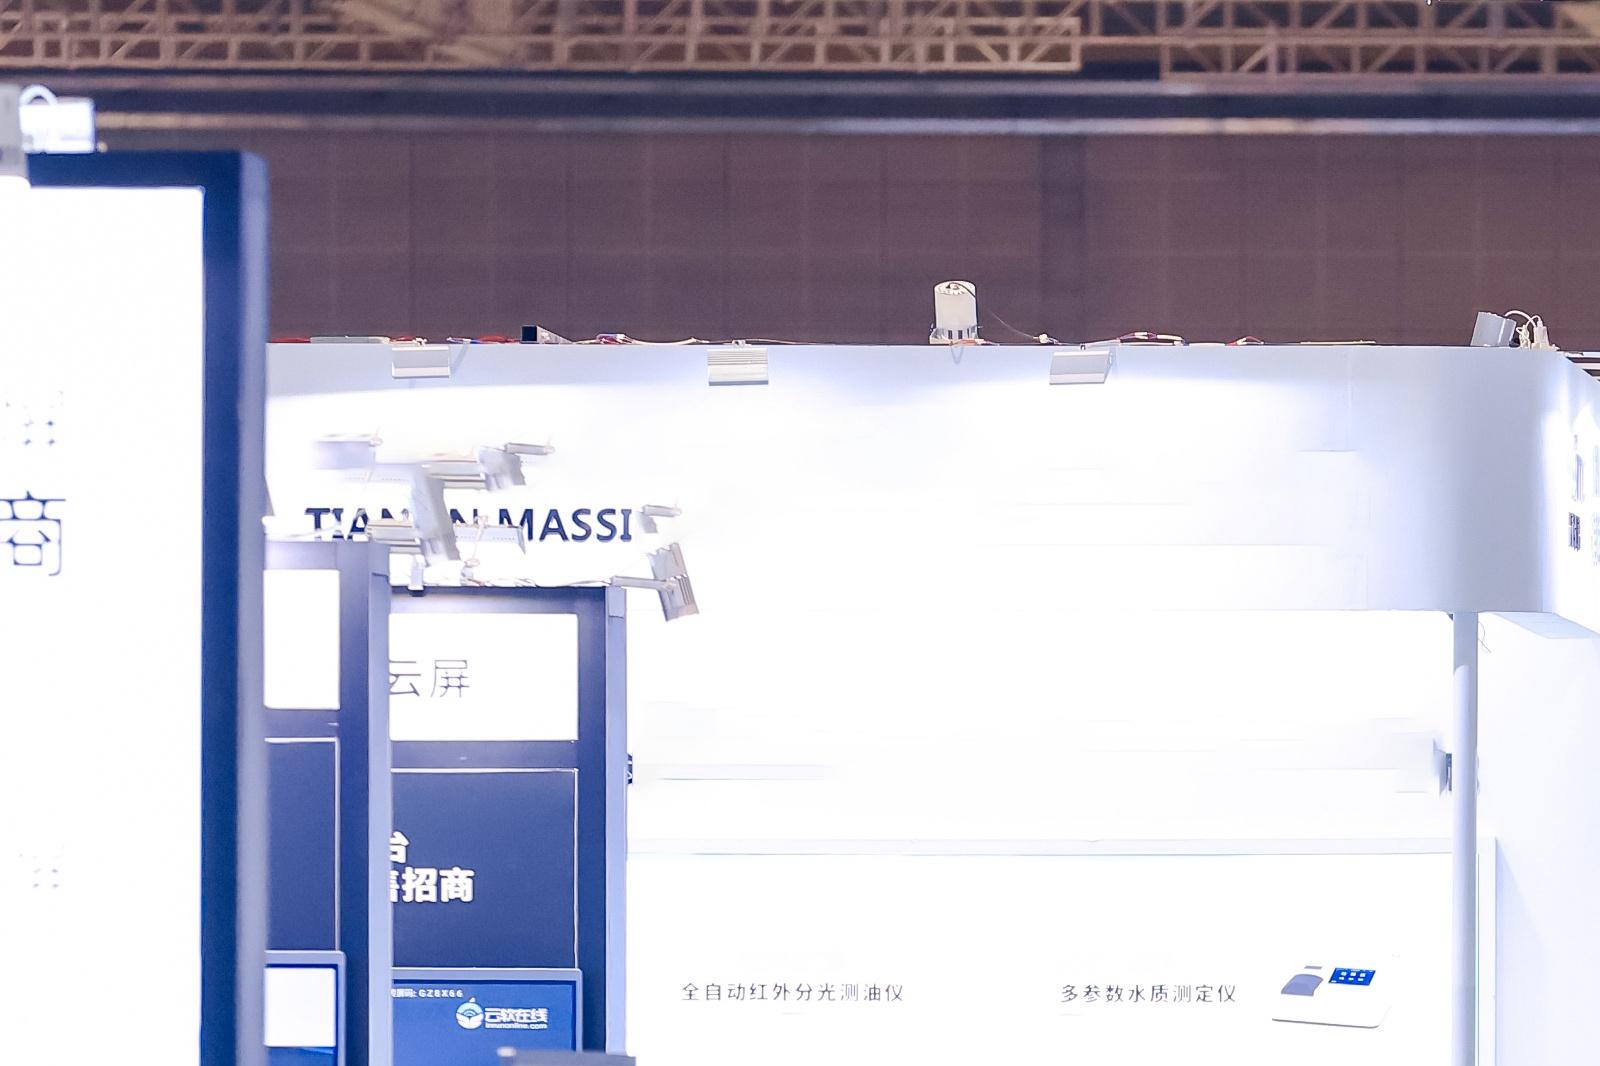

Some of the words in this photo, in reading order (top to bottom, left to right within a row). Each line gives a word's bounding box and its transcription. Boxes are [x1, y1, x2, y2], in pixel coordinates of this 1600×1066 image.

[389, 659, 470, 698] 云屏
[682, 983, 904, 1001] 全自动红外分光测油仪
[1061, 984, 1236, 1003] 多参数水质测定仪
